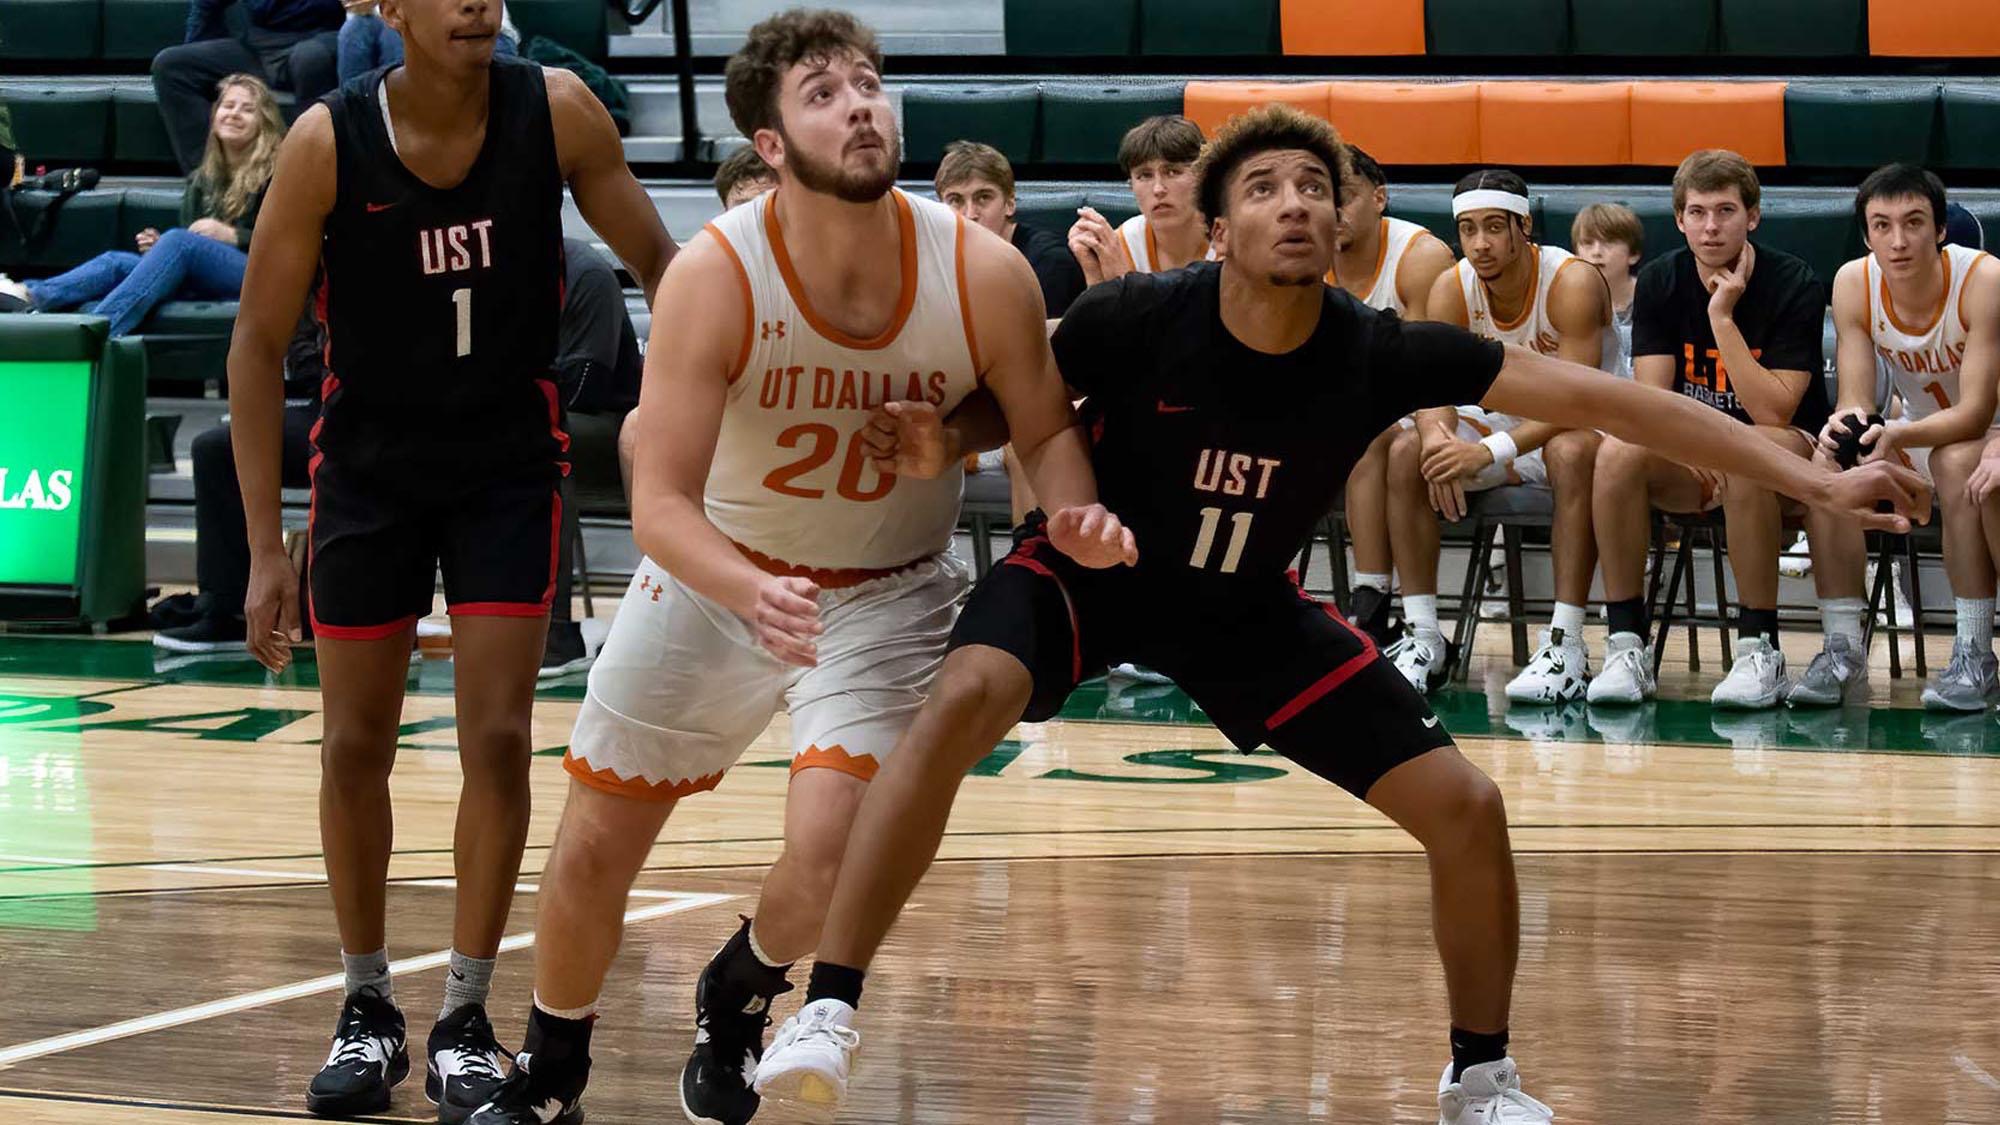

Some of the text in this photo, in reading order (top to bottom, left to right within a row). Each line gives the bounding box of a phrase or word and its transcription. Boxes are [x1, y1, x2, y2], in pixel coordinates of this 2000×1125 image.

[418, 218, 494, 276] UST
[452, 287, 472, 357] 1
[759, 366, 805, 410] UT
[1193, 448, 1282, 499] UST
[1189, 506, 1255, 573] 11
